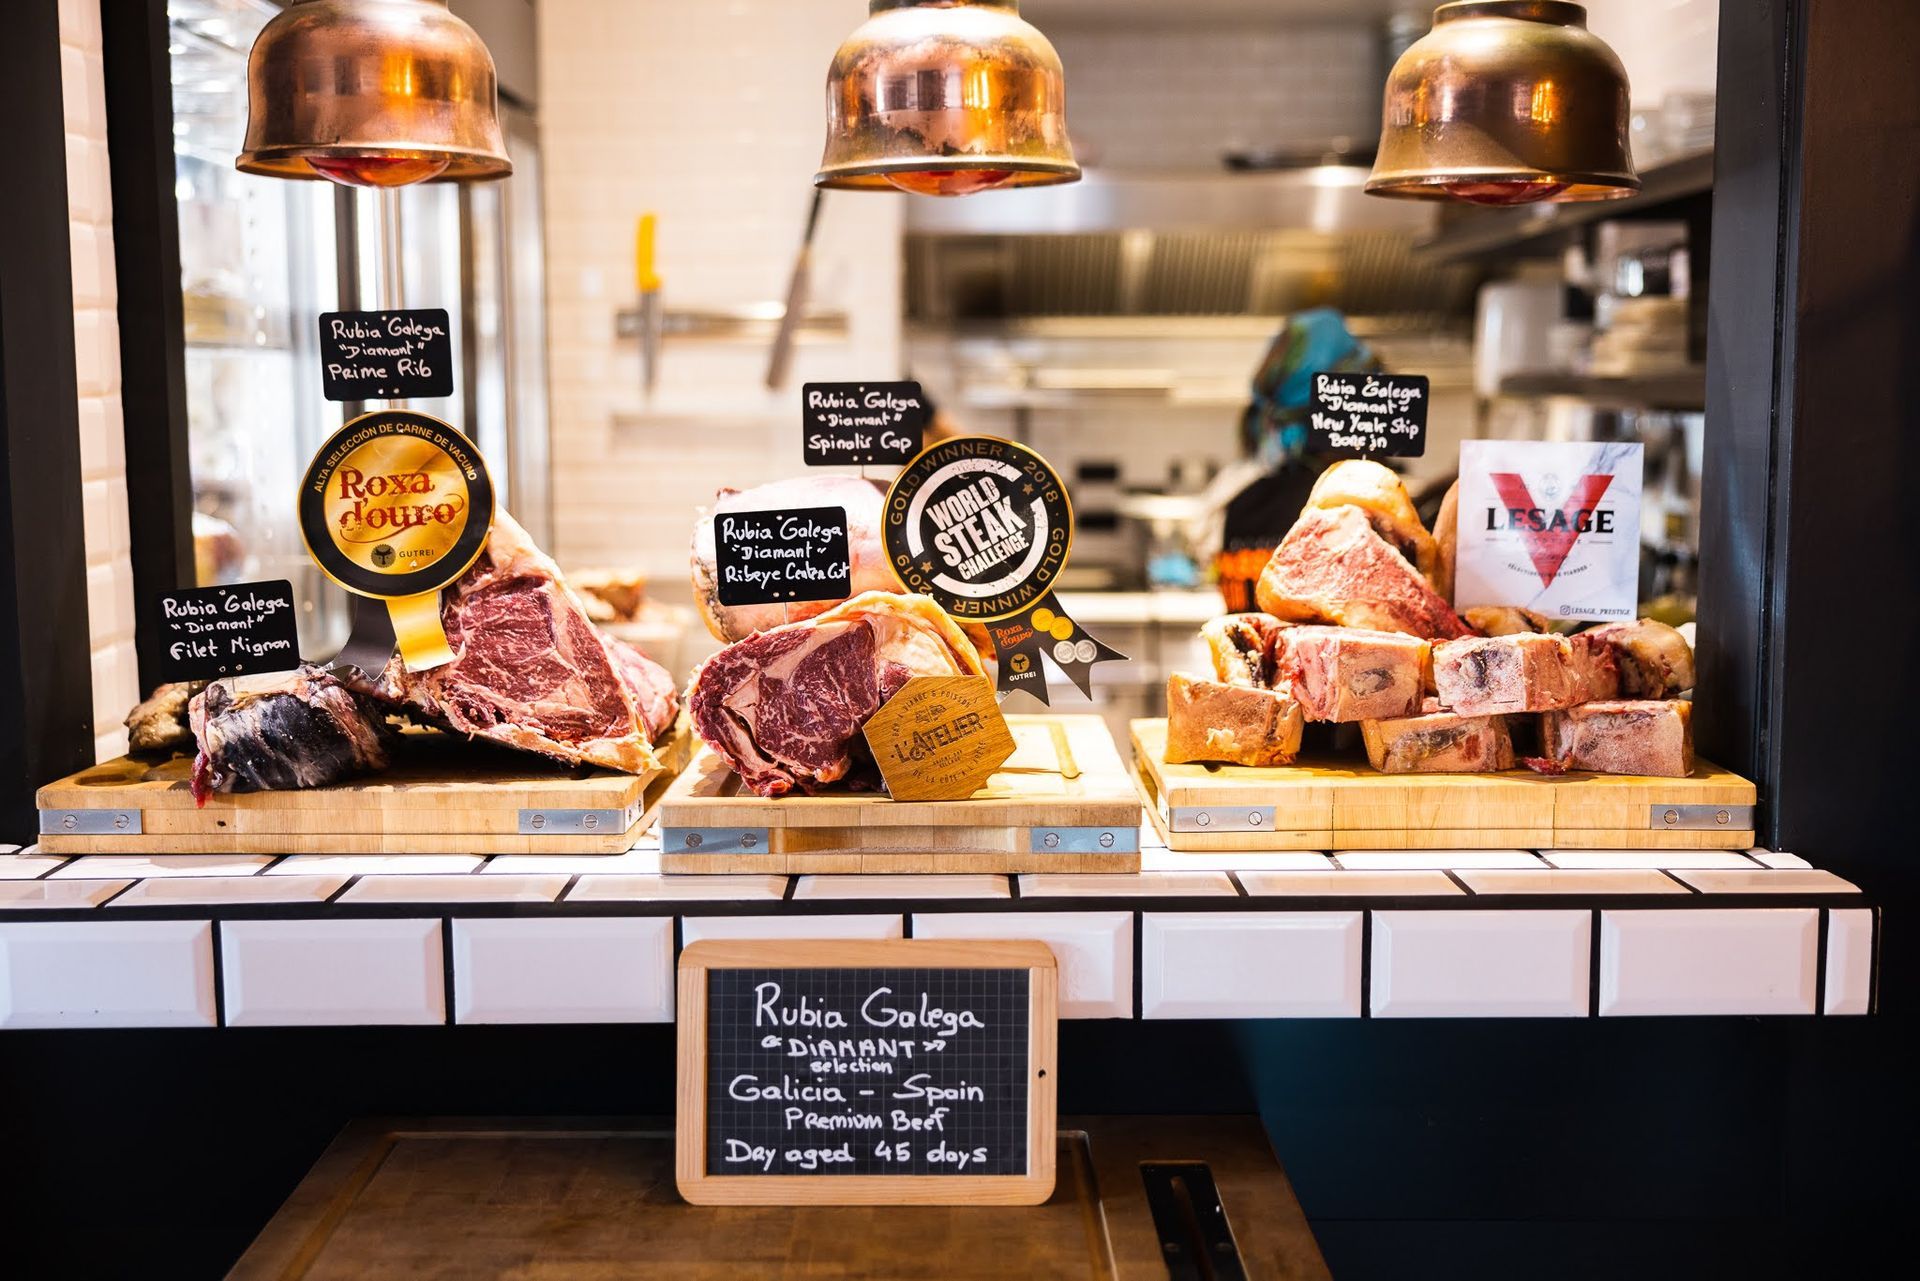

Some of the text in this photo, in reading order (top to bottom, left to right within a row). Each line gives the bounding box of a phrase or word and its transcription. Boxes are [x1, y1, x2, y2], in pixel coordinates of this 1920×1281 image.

[331, 317, 445, 341] Rubia Galega
[397, 358, 432, 377] Rib
[809, 390, 920, 411] Rubia Galega
[1317, 375, 1421, 405] Rubia Galega
[1311, 412, 1344, 431] New
[808, 431, 912, 456] Spinalis Cap
[1328, 432, 1366, 447] Bone
[314, 423, 478, 493] ALTA SELECCIÓN DE CARNE DE VACUNO
[338, 465, 435, 500] Roxa
[890, 442, 1059, 525] GOLD WINNER 2018
[339, 498, 461, 533] d'ouro
[925, 476, 1001, 531] WORLD
[723, 517, 842, 543] Rubia Galega
[933, 495, 1028, 567] STEAK
[1486, 507, 1615, 533] LESAGE
[399, 549, 434, 558] GUTREI
[957, 530, 1030, 580] CHALLENGE
[725, 565, 781, 589] Ribeye
[827, 561, 850, 579] Cut
[896, 527, 1065, 614] GOLD WINNER 2019
[163, 592, 290, 618] Rubia Galega
[996, 624, 1024, 639] Roxa
[170, 636, 291, 660] Filet Mignon
[1009, 671, 1037, 682] GUTREI
[894, 712, 984, 763] L'ATELIER
[755, 982, 985, 1036] Rubia Galega
[809, 1058, 893, 1074] selection
[728, 1074, 847, 1102] Galicia
[892, 1073, 985, 1106] Spain
[891, 1107, 950, 1131] Beef
[785, 1142, 856, 1169] aged
[874, 1140, 911, 1163] 45
[926, 1140, 988, 1170] days
